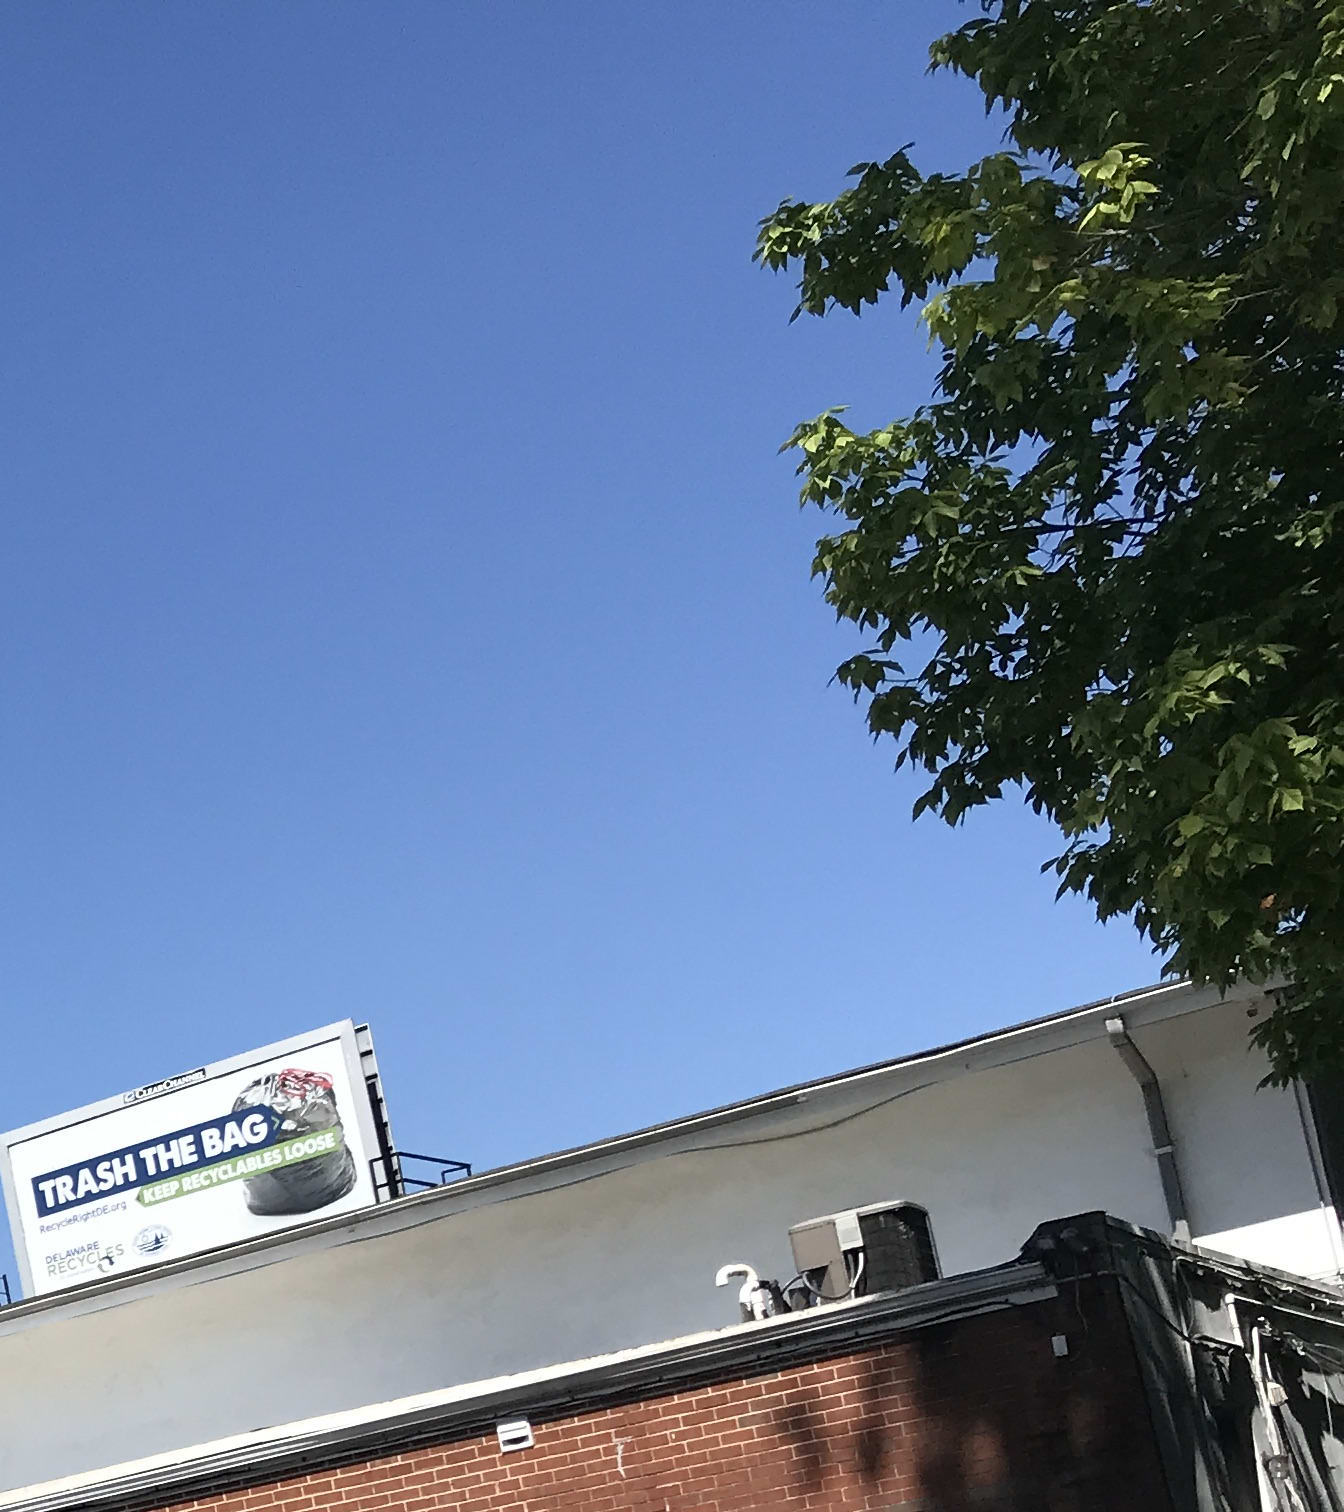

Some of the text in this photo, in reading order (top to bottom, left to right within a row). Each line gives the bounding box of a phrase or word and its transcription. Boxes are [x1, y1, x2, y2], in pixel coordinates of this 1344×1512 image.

[39, 1114, 268, 1208] TRASH THE BAG
[143, 1133, 336, 1203] KEEP RECYCLABLES LOOSE
[40, 1201, 127, 1234] RecycleRightDE.org
[45, 1241, 100, 1264] DELAWARE
[47, 1244, 124, 1277] RECYCLES
